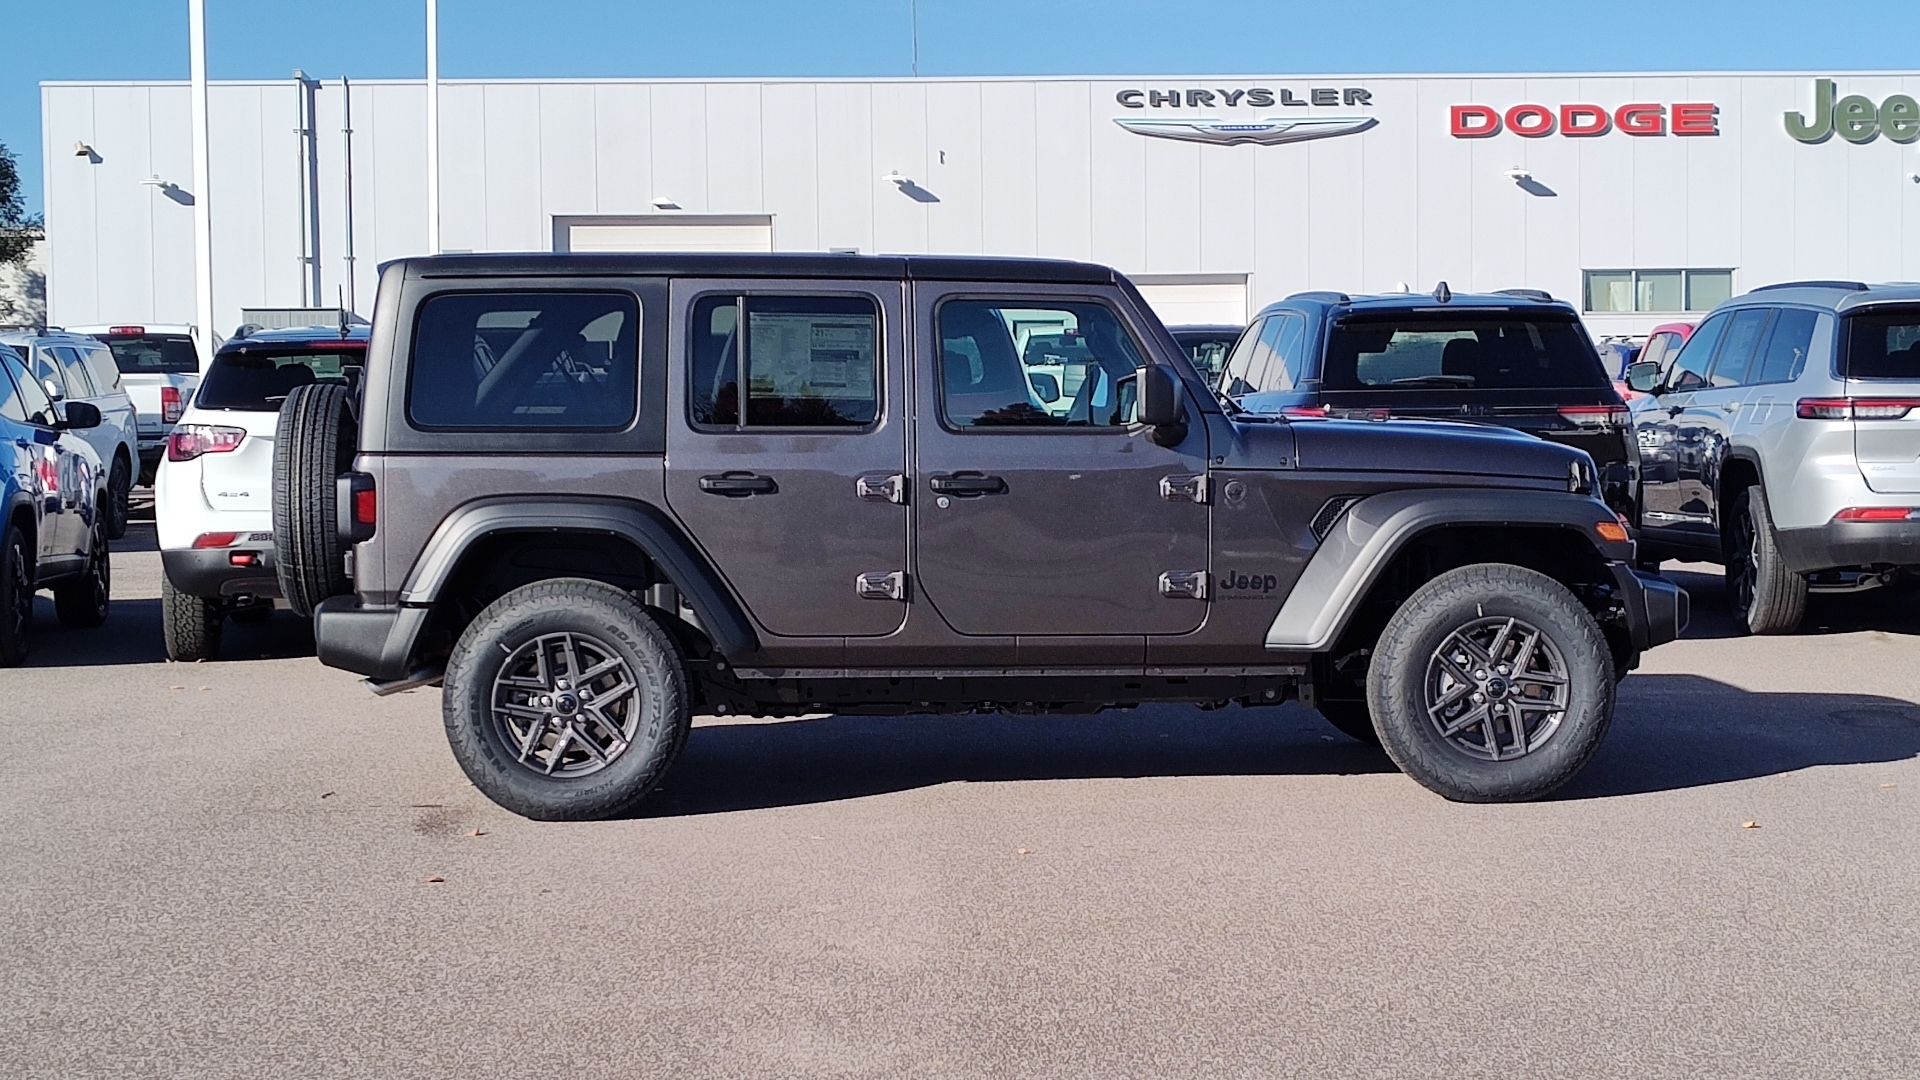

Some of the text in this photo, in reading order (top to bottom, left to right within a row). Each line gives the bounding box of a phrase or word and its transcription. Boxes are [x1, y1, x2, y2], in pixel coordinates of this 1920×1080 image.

[1115, 88, 1373, 108] CHRYSLER
[1450, 103, 1720, 138] DODGE
[1220, 569, 1278, 593] Jeep
[606, 625, 660, 687] ROADIAN
[470, 693, 506, 774] NEXEN
